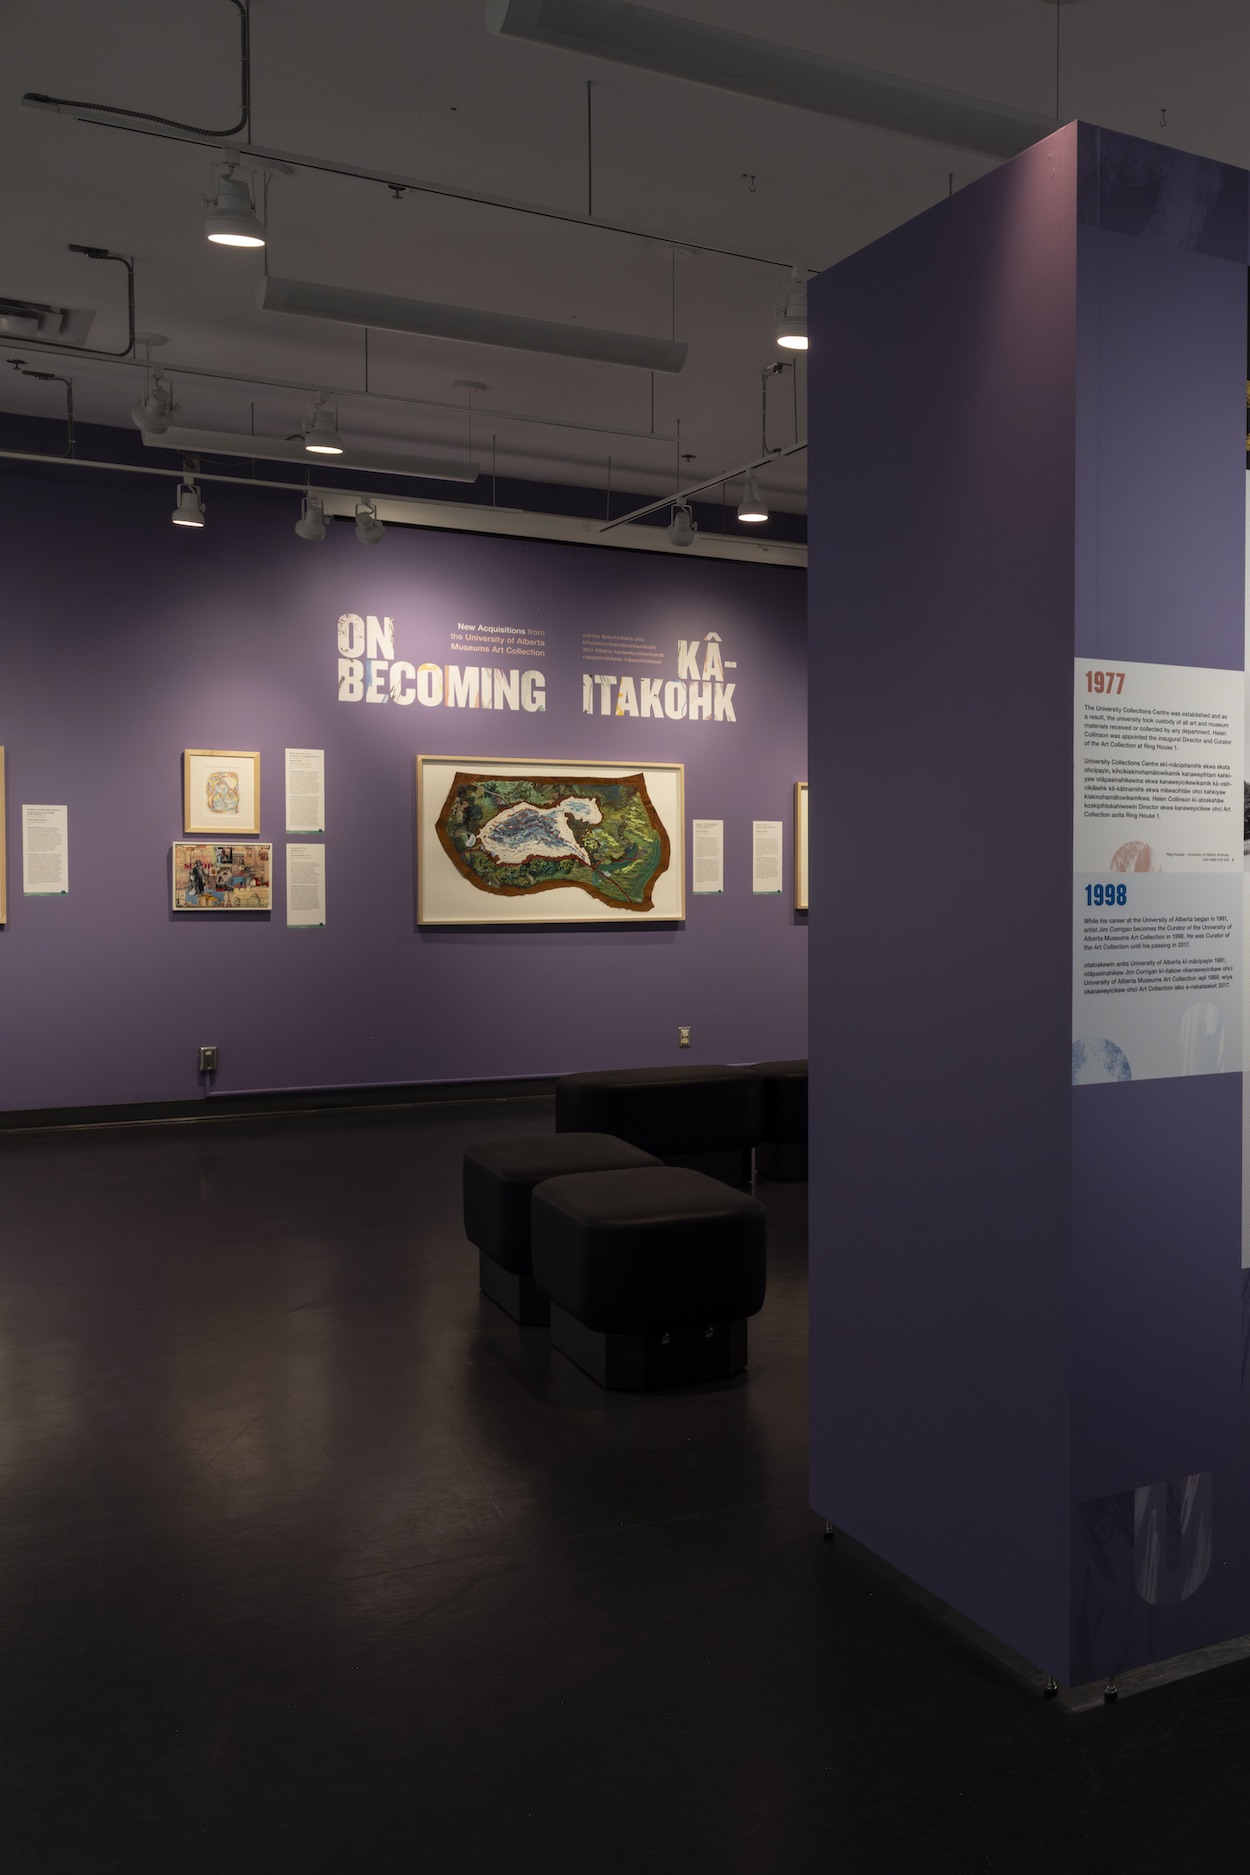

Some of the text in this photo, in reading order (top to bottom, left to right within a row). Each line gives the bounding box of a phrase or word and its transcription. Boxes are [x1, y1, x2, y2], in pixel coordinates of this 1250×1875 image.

[458, 622, 545, 636] New Acquisitions from
[338, 613, 394, 660] ON
[450, 632, 545, 646] the University of Alberta
[450, 642, 545, 656] Museums Art Collection
[677, 632, 737, 682] KÂ-
[338, 658, 546, 713] BECOMING
[1085, 670, 1125, 695] 1977
[582, 674, 738, 722] ITAKOHK
[1095, 704, 1122, 714] University
[1122, 706, 1151, 714] Collections
[1181, 710, 1210, 718] established
[1083, 730, 1109, 738] Collinson
[1121, 732, 1148, 742] appointed
[1157, 734, 1181, 743] inaugural
[1085, 884, 1126, 906] 1998
[1142, 916, 1168, 924] University
[1193, 915, 1209, 923] began
[1150, 941, 1171, 950] passing
